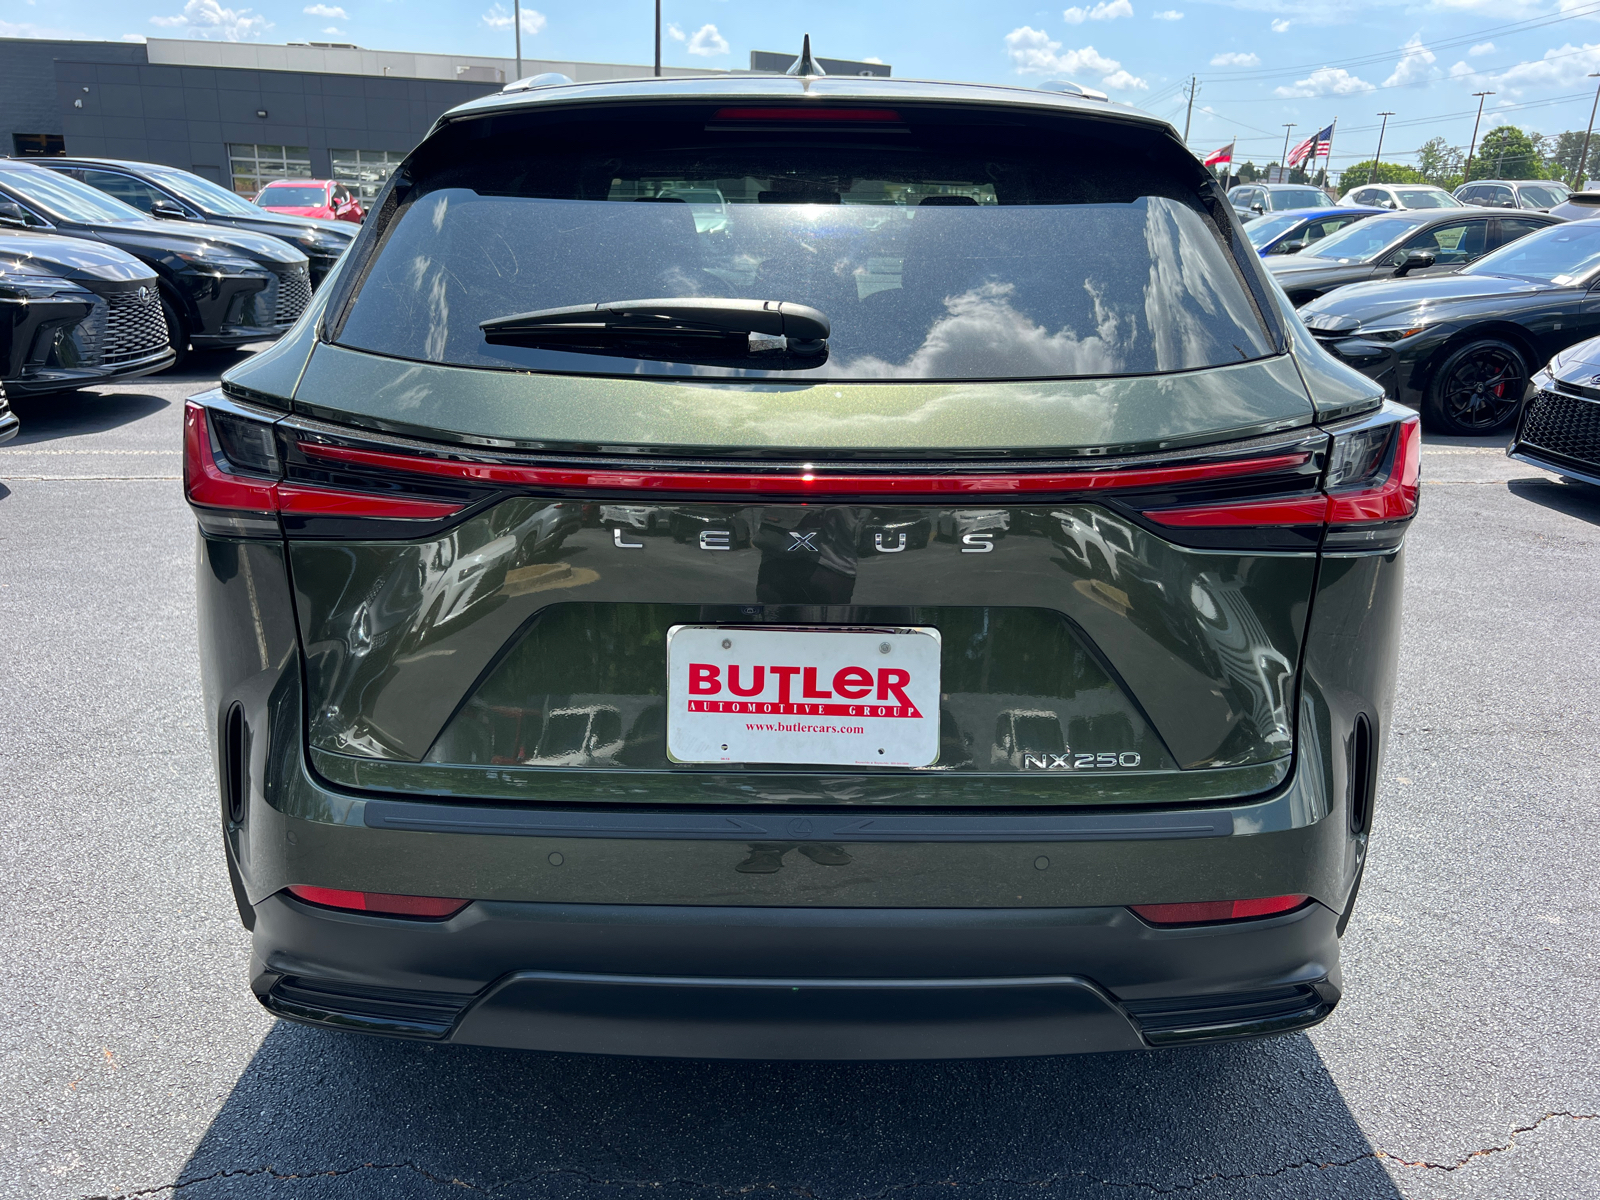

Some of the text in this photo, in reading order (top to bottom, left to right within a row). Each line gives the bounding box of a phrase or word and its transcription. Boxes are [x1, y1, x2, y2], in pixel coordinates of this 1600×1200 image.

[613, 528, 994, 553] LEXUS
[689, 702, 915, 717] AUTOMOTIVE GROUP
[746, 722, 864, 734] www.butlercars.com
